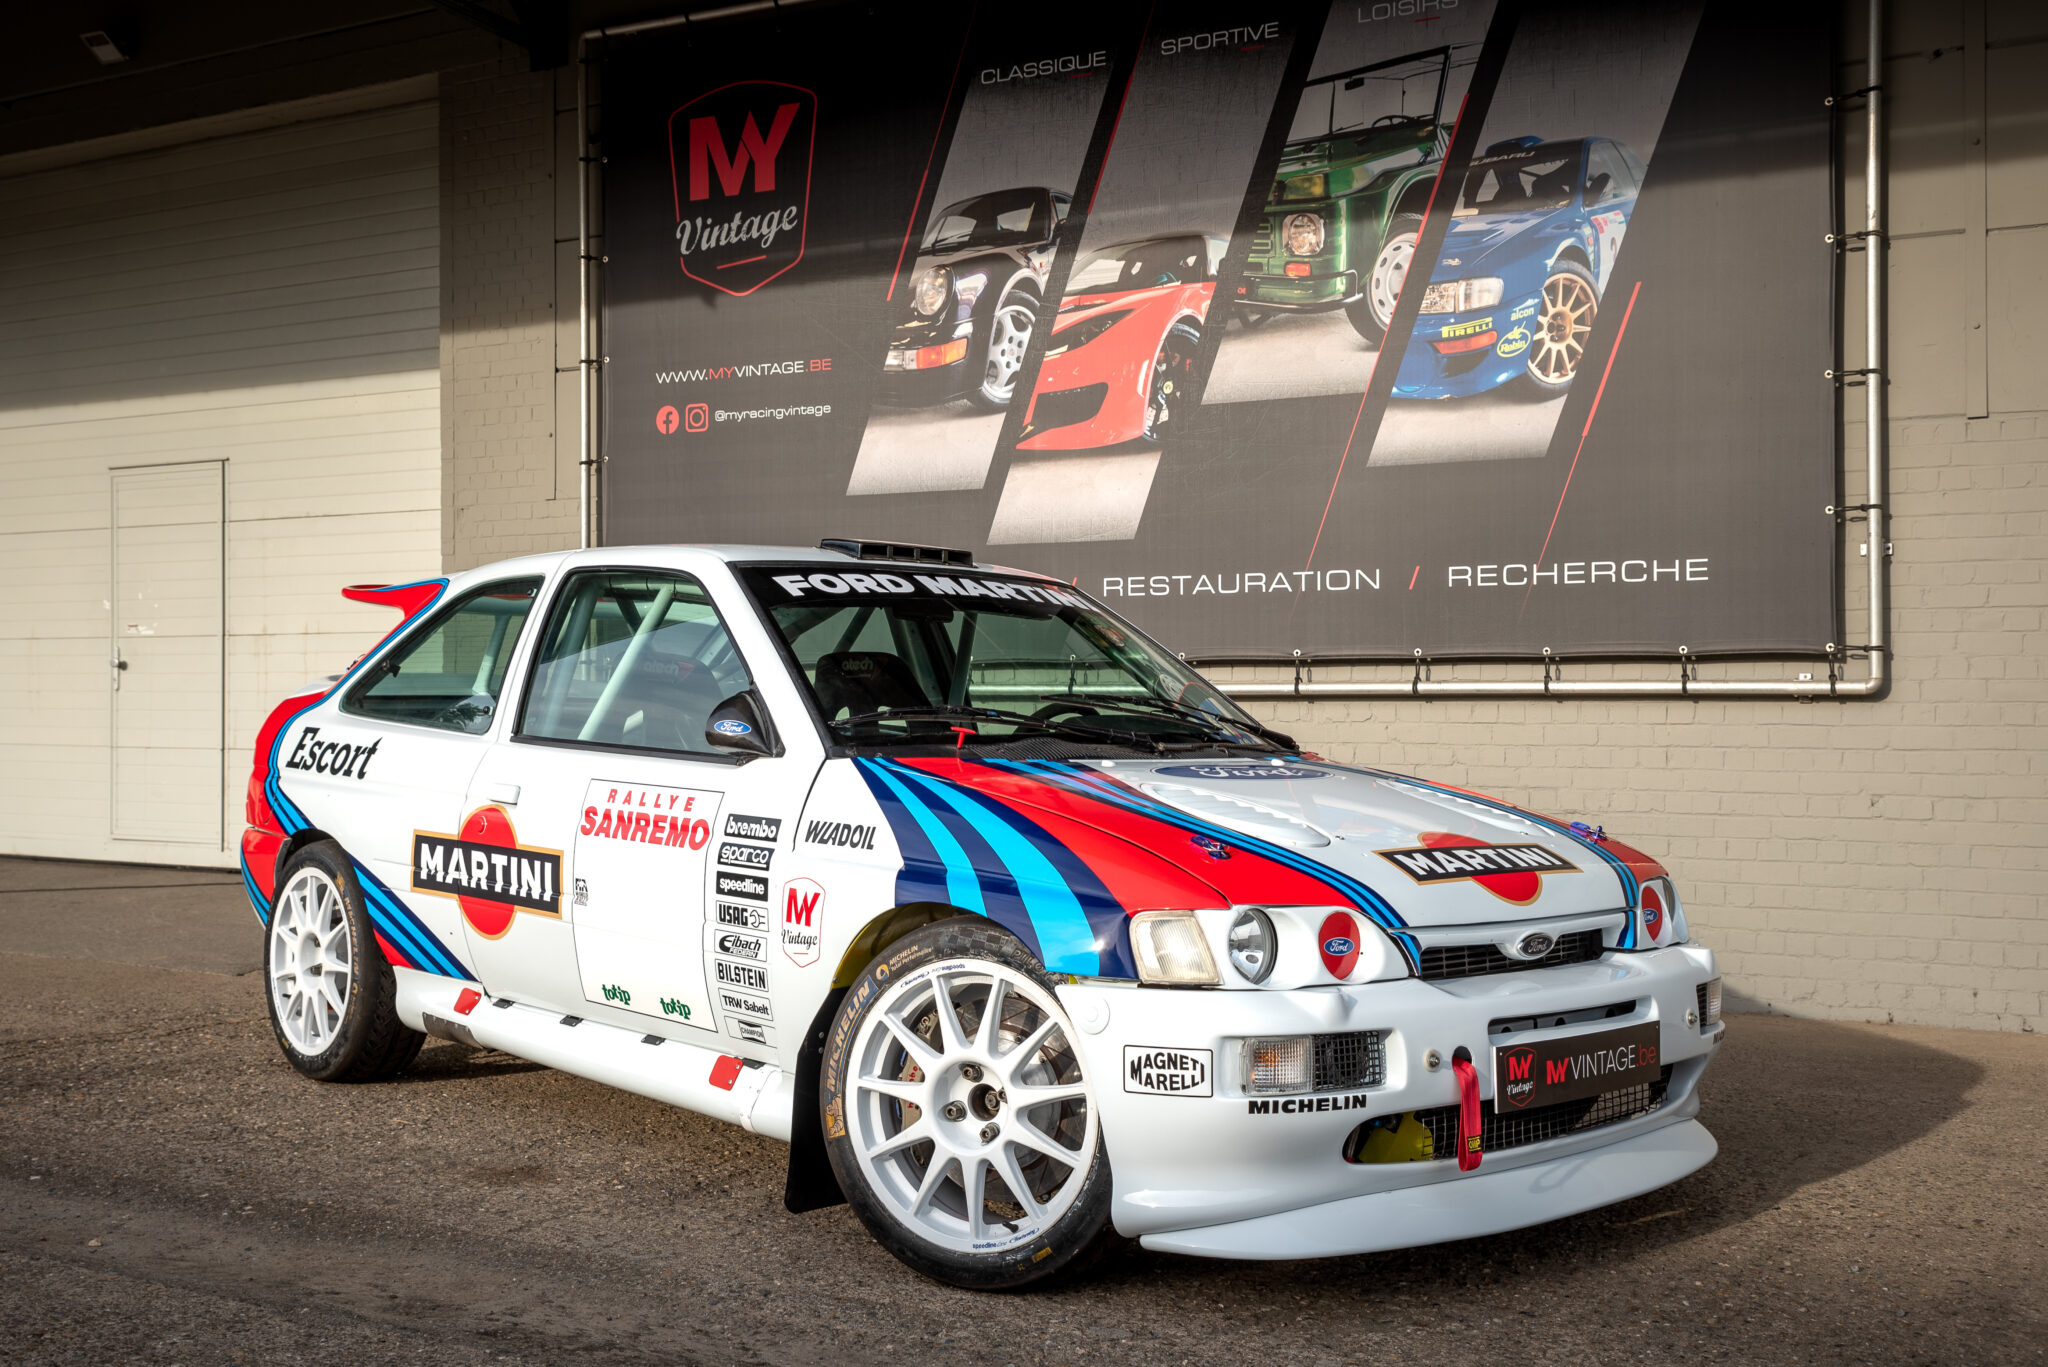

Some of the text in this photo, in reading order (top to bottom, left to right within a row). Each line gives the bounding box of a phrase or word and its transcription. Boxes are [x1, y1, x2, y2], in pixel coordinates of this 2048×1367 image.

[1161, 21, 1279, 56] SPORTIVE
[980, 50, 1107, 86] CLASSIQUE
[689, 102, 801, 202] MY
[676, 205, 798, 255] Vintage
[1441, 317, 1493, 339] PIRELLI
[655, 358, 832, 384] WWW.MYVINTAGE.BE
[714, 404, 832, 423] @myracingvintage
[771, 573, 915, 597] FORD
[1103, 568, 1380, 597] RESTAURATION
[1448, 558, 1709, 588] RECHERCHE
[720, 721, 743, 732] Ford
[285, 726, 383, 780] Escort
[1189, 764, 1303, 778] Ford
[607, 788, 696, 812] RALLYE
[580, 805, 710, 851] SANREMO
[726, 816, 777, 839] brembo
[721, 845, 769, 864] sparco
[1393, 847, 1564, 876] MARTINI
[420, 842, 553, 902] MARTINI
[719, 878, 765, 895] speedline
[719, 903, 748, 926] USAG
[786, 887, 821, 927] MY
[719, 934, 762, 953] Eibach
[781, 928, 818, 950] Vintage
[1330, 940, 1349, 952] Ford
[1527, 937, 1550, 952] Ford
[889, 944, 919, 966] MICHELIN
[717, 962, 766, 989] BILSTEIN
[602, 984, 631, 1006] totip
[722, 994, 770, 1016] TRW Sabelt
[660, 997, 691, 1020] totip
[826, 980, 871, 1092] MICHELIN
[1509, 1053, 1533, 1081] MY
[1506, 1080, 1534, 1096] Vintage
[1248, 1094, 1367, 1115] MICHELIN
